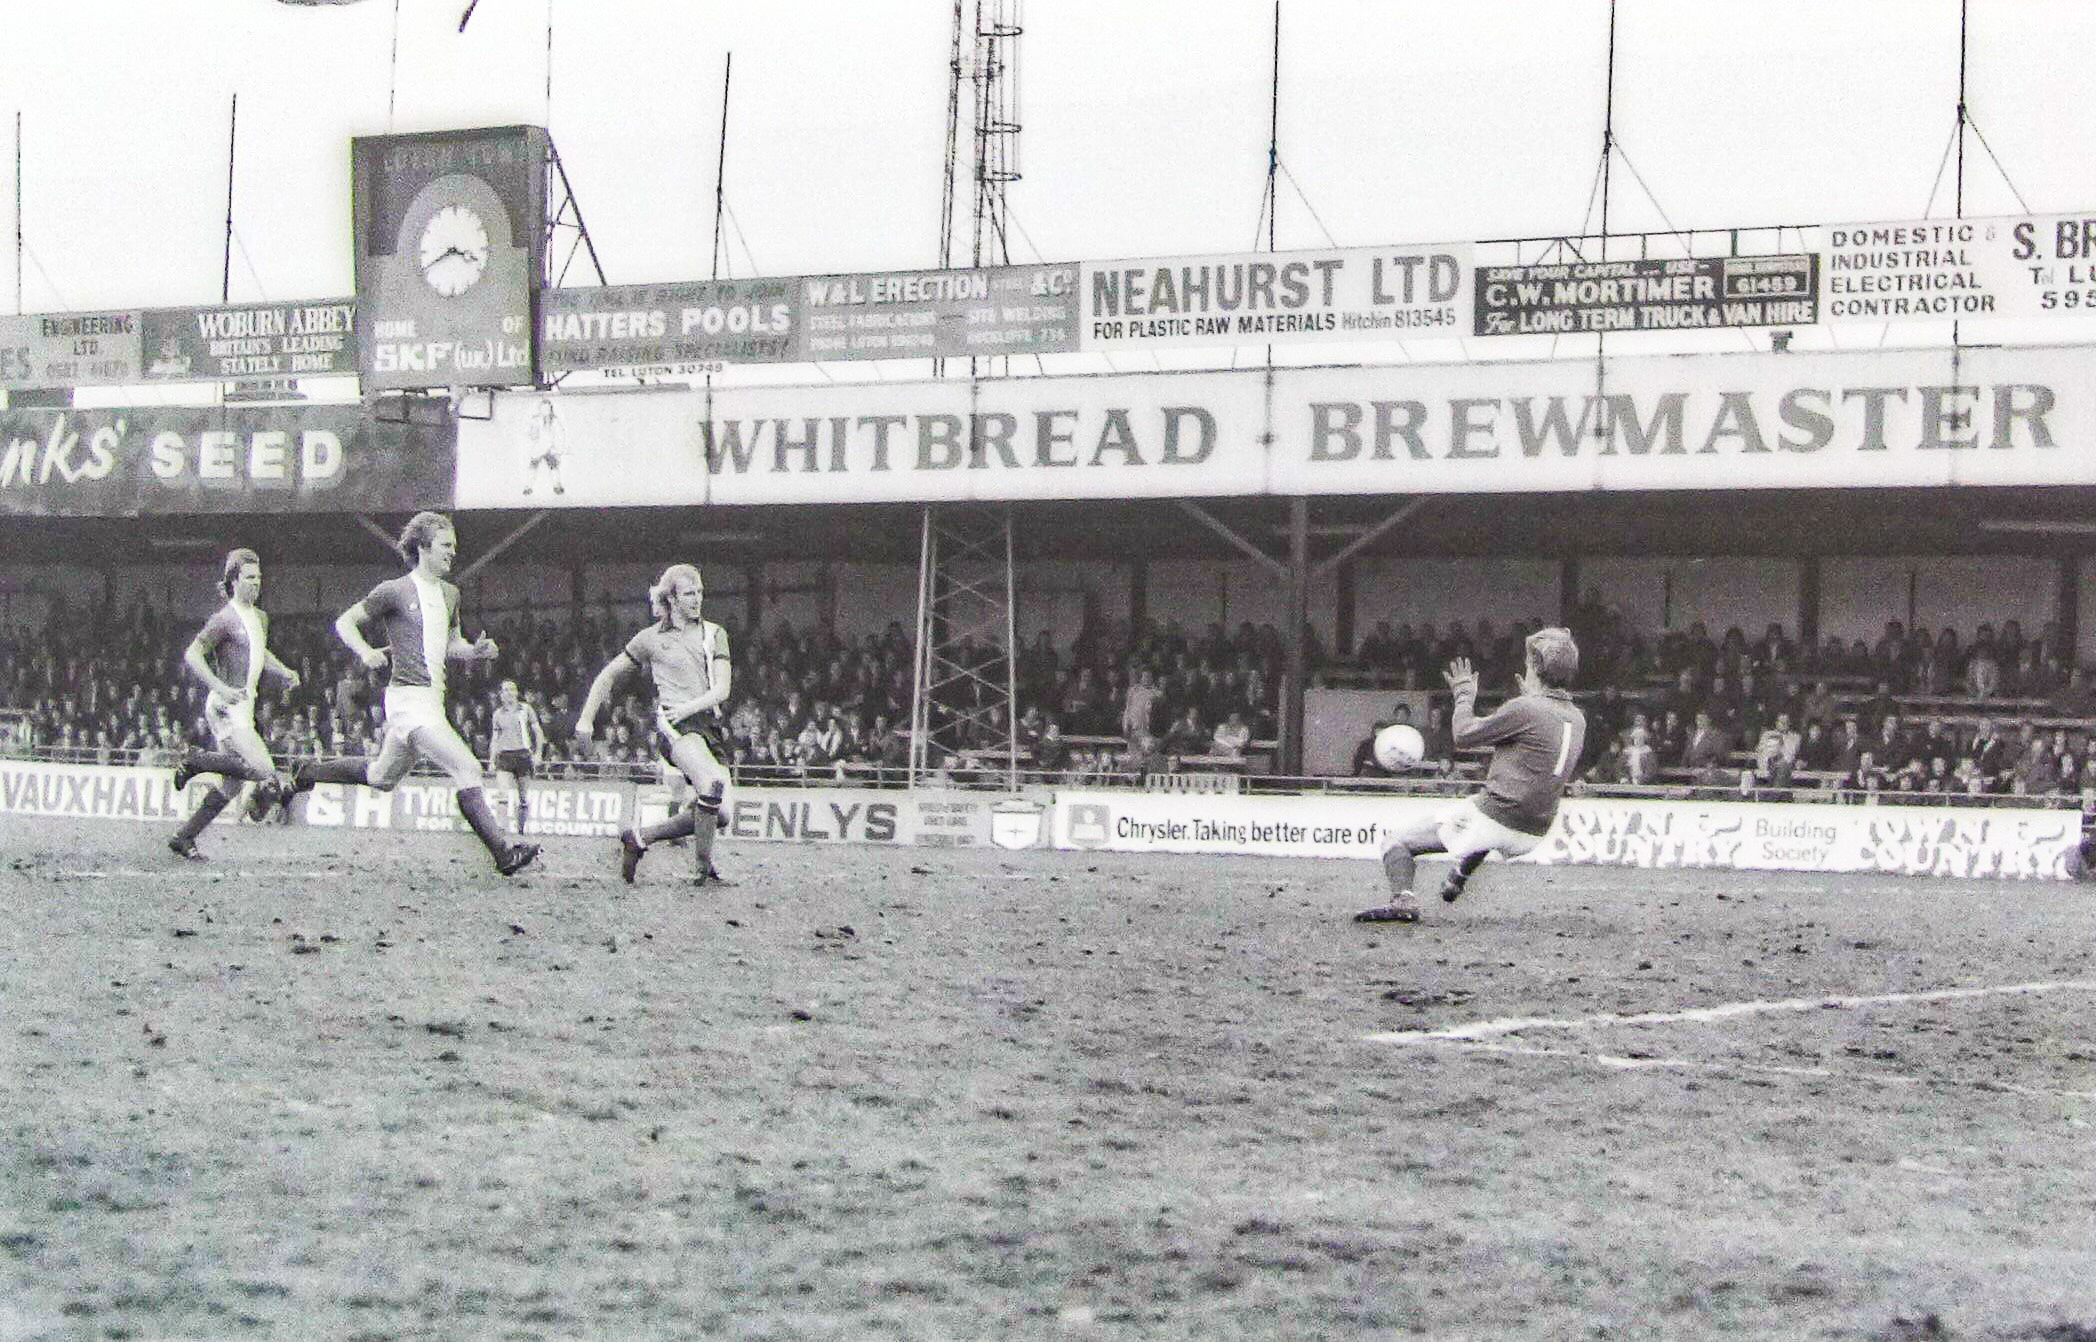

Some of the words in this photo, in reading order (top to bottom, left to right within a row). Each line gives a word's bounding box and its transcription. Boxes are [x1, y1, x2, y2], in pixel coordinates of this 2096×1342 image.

[1832, 225, 1974, 247] DOMESTIC
[2013, 222, 2042, 260] S.
[1528, 266, 1570, 281] YOUR
[1574, 263, 1636, 279] CAPITAL
[1831, 250, 1972, 271] INDUSTRIAL
[872, 274, 989, 304] ERECTION
[1093, 260, 1343, 317] NEAHURST
[1372, 254, 1460, 305] LTD
[1831, 272, 1982, 293] ELECTRICAL
[1520, 309, 1574, 332] LONG
[1579, 307, 1635, 330] TERM
[1640, 304, 1706, 327] TRUCK
[1708, 307, 1721, 325] &
[1721, 303, 1761, 324] VAN
[1766, 301, 1814, 323] HIRE
[1831, 295, 1997, 316] CONTRACTOR
[198, 309, 286, 339] WOBURN
[289, 304, 357, 335] ABBEY
[502, 315, 525, 334] OF
[545, 310, 666, 341] HATTERS
[681, 303, 791, 335] POOLS
[1093, 321, 1123, 340] FOR
[1129, 319, 1191, 338] PLASTIC
[1196, 316, 1231, 335] RAW
[1238, 313, 1335, 334] MATERIALS
[1343, 311, 1391, 331] Hitchin
[1395, 308, 1456, 329] 813545
[282, 335, 344, 352] LEADING
[374, 341, 452, 372] SKF
[221, 355, 279, 375] STATELY
[292, 353, 333, 371] HOME
[700, 406, 1217, 475] WHITBREAD
[1308, 384, 2057, 461] BREWMASTER
[151, 429, 344, 479] SEED
[1553, 721, 1572, 777] 1
[2, 771, 178, 817] VAUXHALL
[576, 792, 622, 822] LTD
[509, 820, 619, 836] DSCOUNTS
[718, 800, 898, 841] ENLYS
[1193, 819, 1247, 845] Taking
[1251, 820, 1305, 843] better
[1312, 828, 1352, 844] care
[1357, 822, 1378, 844] of
[1755, 818, 1837, 842] Building
[1762, 842, 1830, 866] Society
